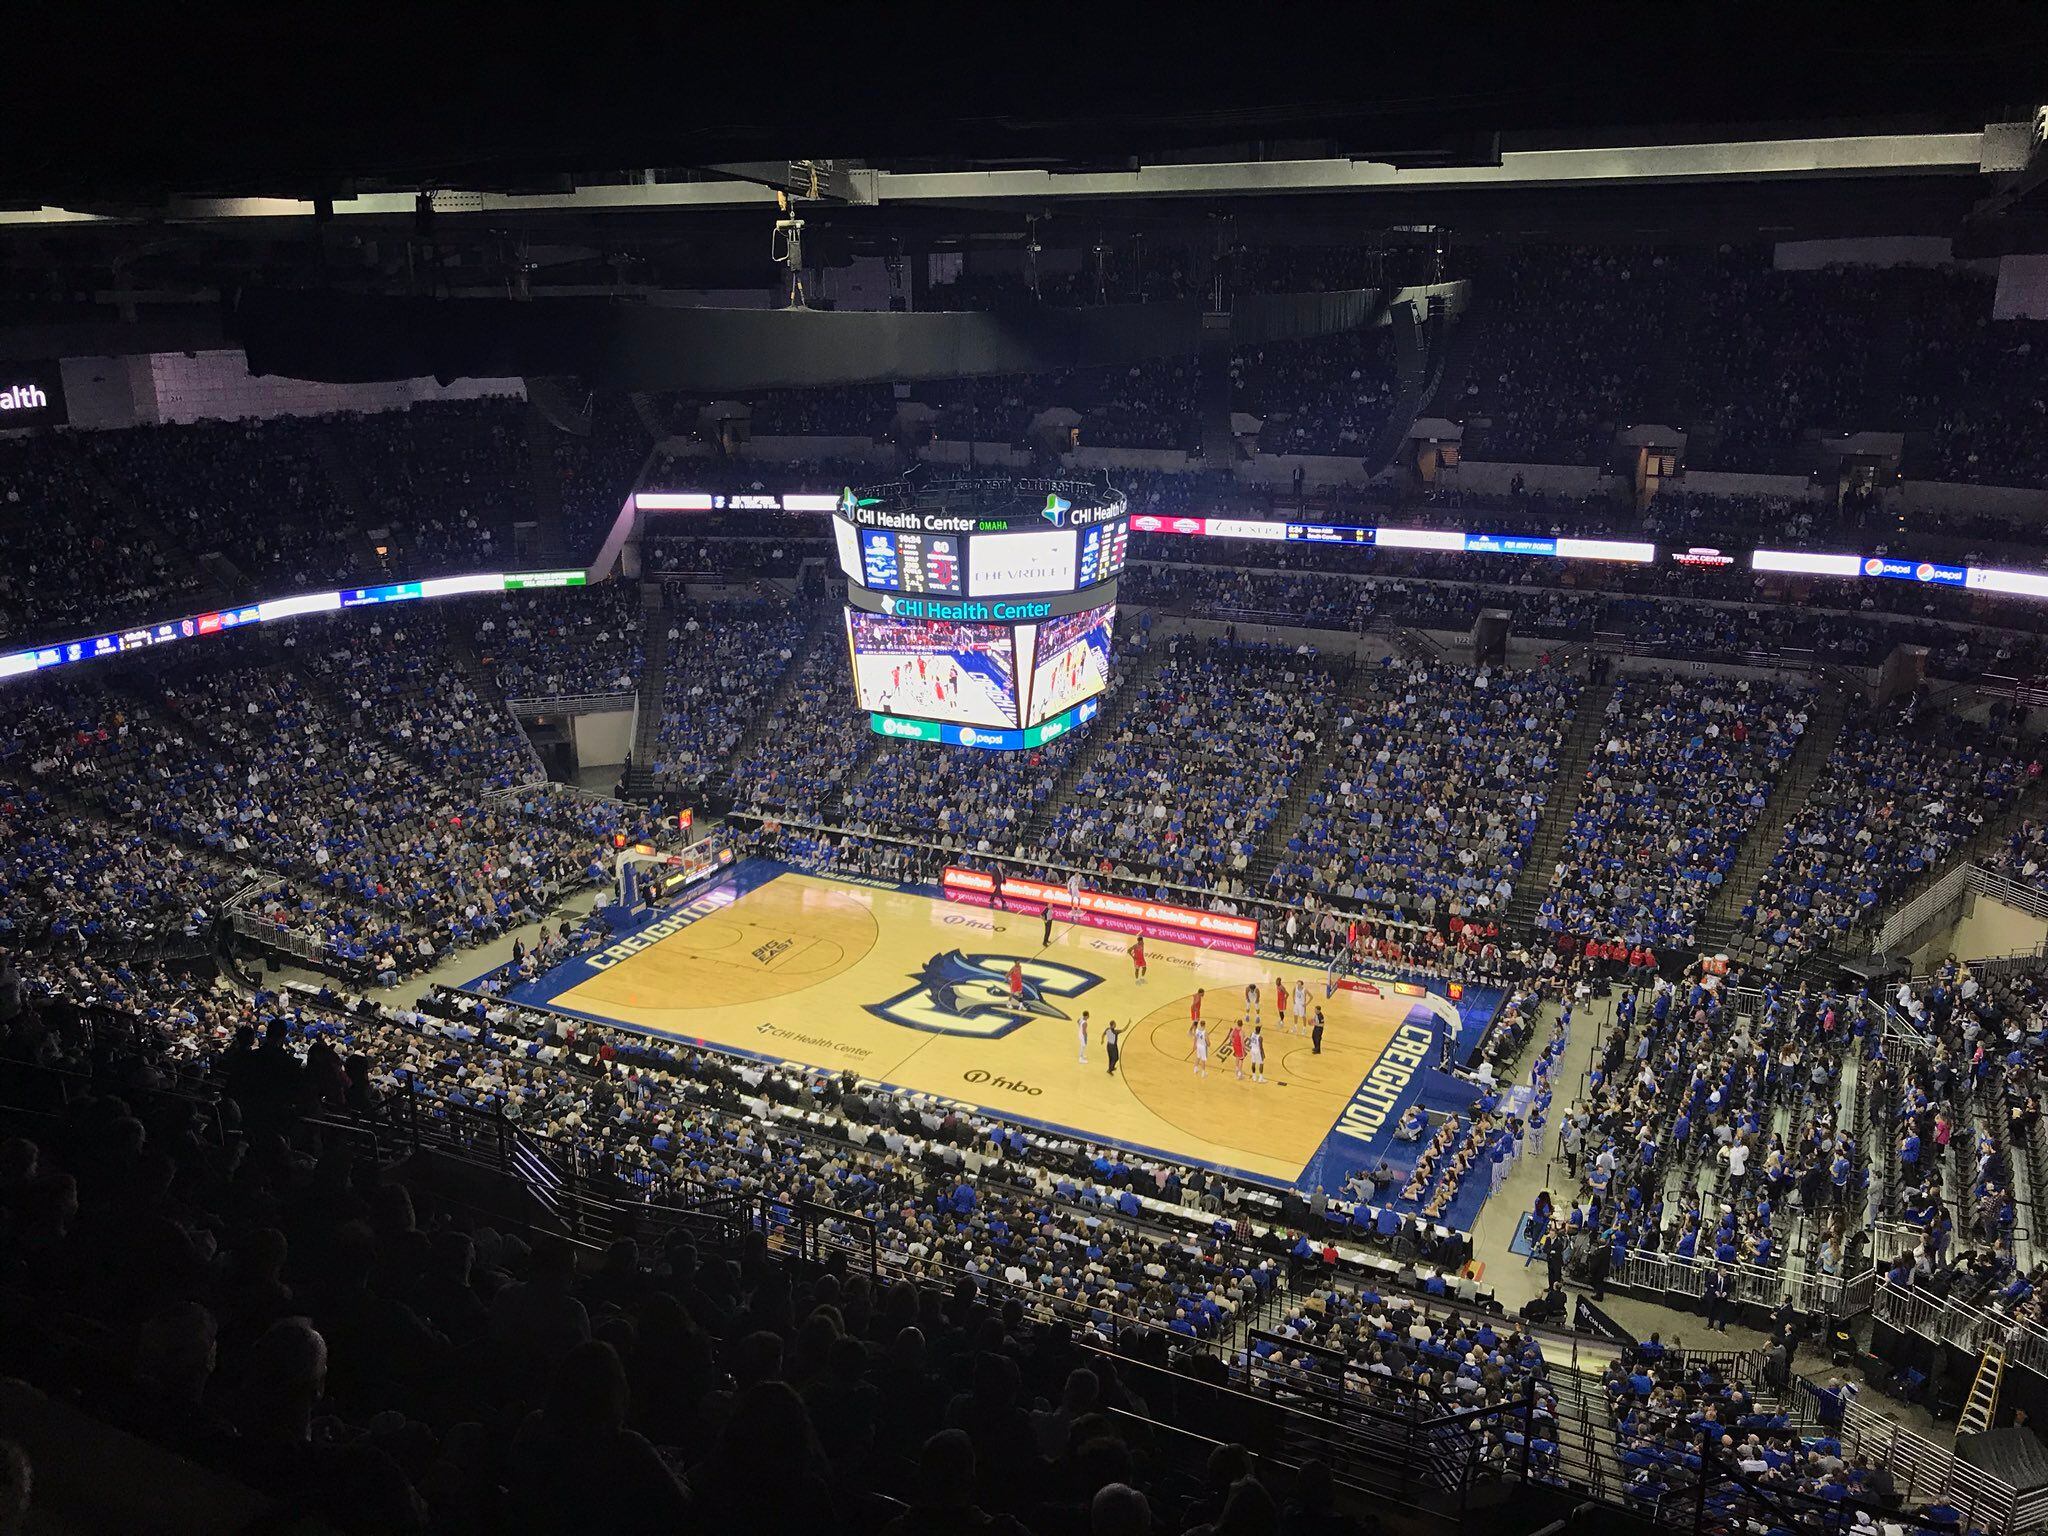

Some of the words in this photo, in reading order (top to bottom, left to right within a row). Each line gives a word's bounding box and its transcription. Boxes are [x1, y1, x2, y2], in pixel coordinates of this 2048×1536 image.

[857, 508, 874, 525] CHI
[877, 511, 920, 529] Health
[924, 515, 976, 531] Center
[979, 521, 1008, 531] OMAHA
[1071, 508, 1091, 525] CHI
[1094, 502, 1119, 521] Health
[1672, 553, 1700, 561] TRUCK
[1700, 555, 1734, 564] CENTER
[1884, 565, 1911, 575] pepsi
[1935, 570, 1962, 580] pepsi
[895, 599, 923, 617] CHI
[927, 602, 988, 620] Health
[993, 602, 1051, 619] Center
[585, 891, 737, 971] CREIGHTON
[965, 920, 1006, 932] fnbo
[752, 939, 779, 957] BIG
[758, 938, 794, 963] EAST
[771, 1028, 795, 1039] CHI
[793, 1033, 833, 1048] Health
[833, 1043, 873, 1056] Center
[990, 1076, 1043, 1096] fnbo
[1335, 1024, 1432, 1143] CREIGHTON
